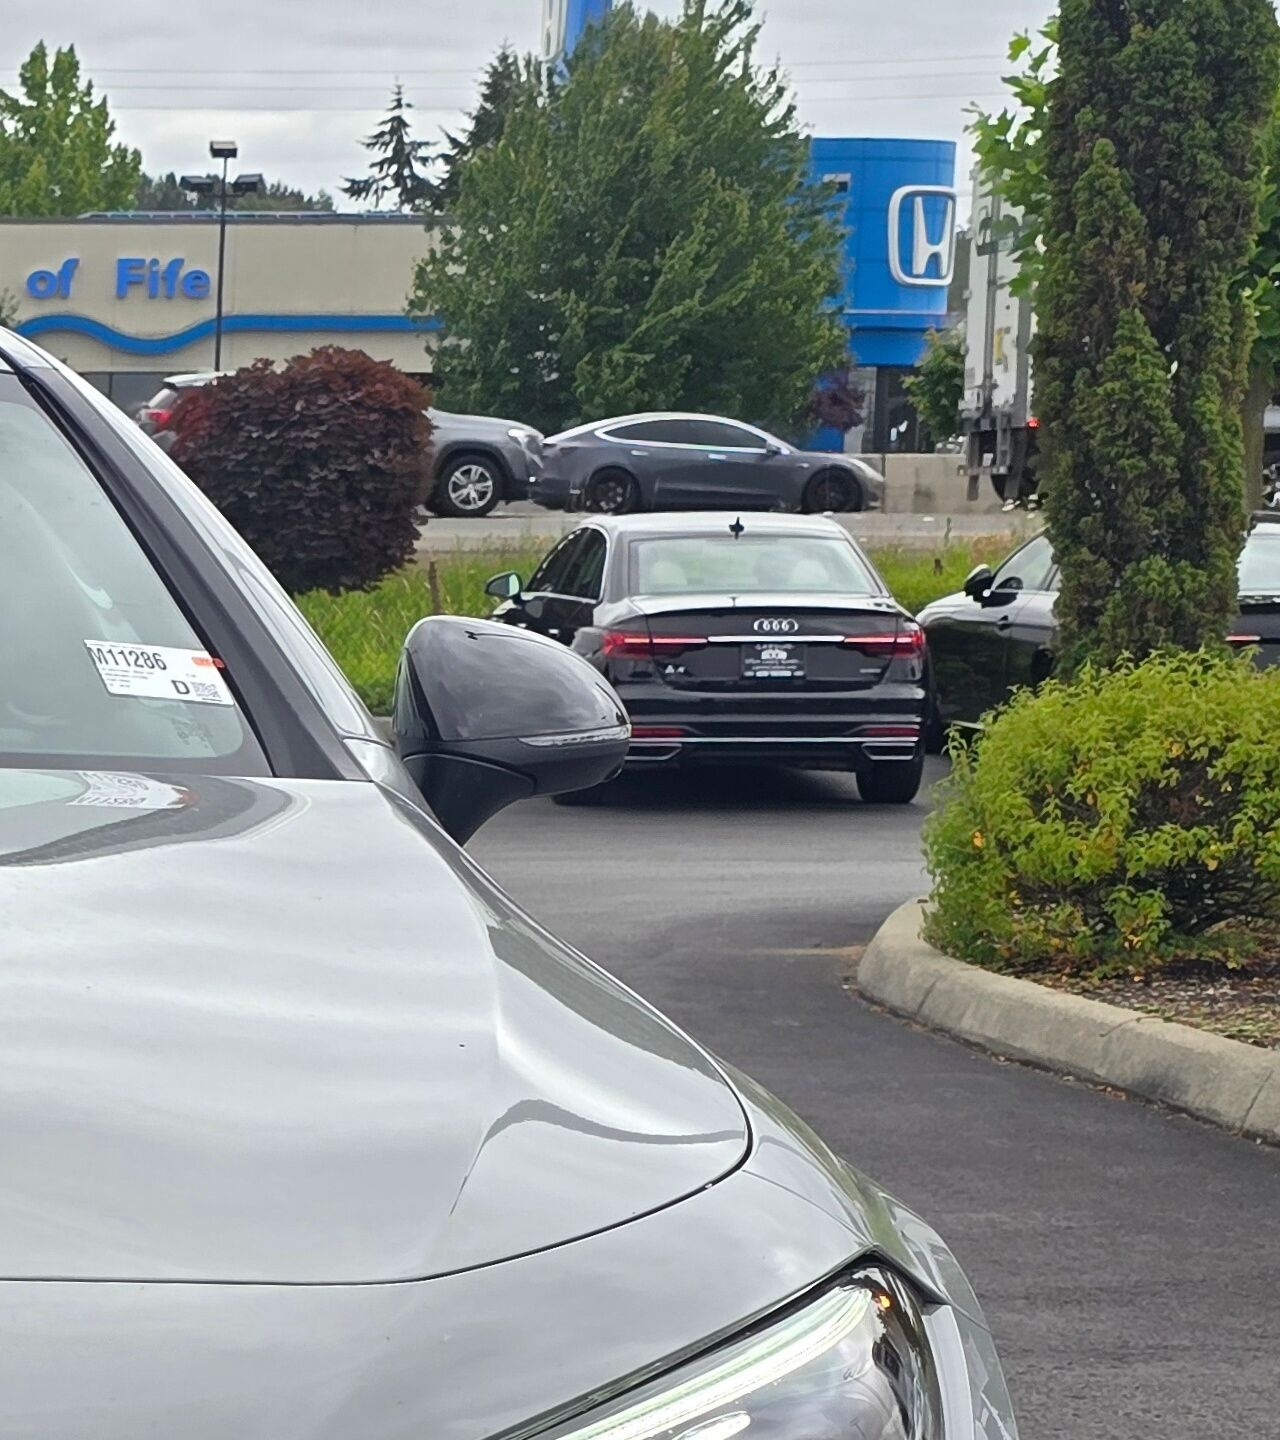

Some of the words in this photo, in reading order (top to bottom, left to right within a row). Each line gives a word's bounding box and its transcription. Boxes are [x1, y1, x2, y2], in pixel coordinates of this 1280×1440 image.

[26, 258, 80, 299] of
[116, 258, 210, 299] Fife
[170, 679, 191, 695] D
